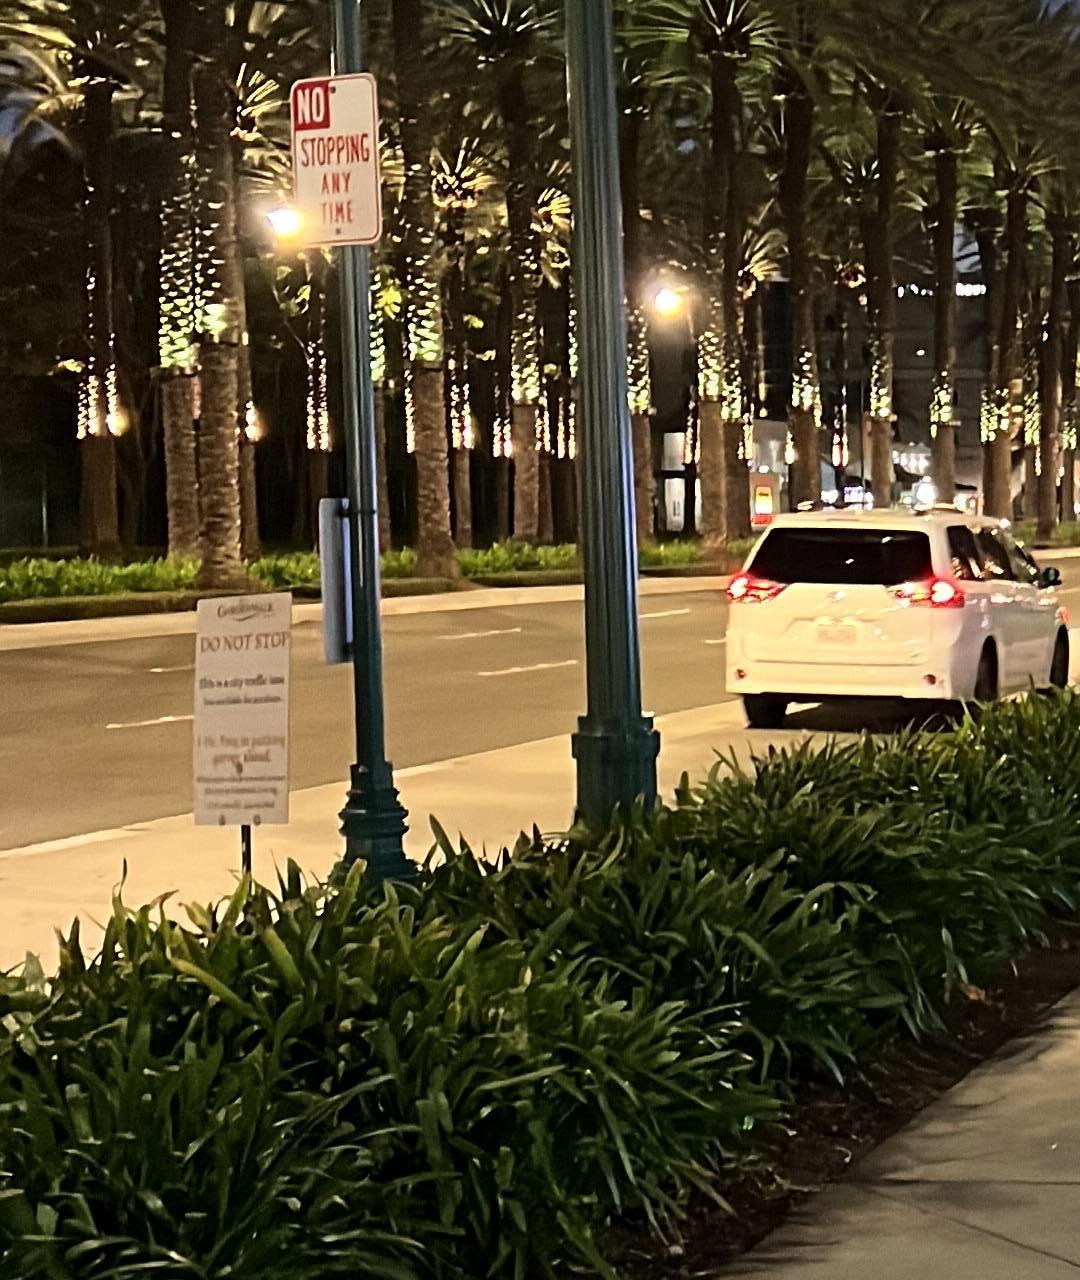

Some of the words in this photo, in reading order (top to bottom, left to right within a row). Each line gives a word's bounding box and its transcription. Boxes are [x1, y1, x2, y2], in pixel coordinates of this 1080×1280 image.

[296, 86, 325, 125] NO
[301, 133, 370, 167] STOPPING
[321, 172, 351, 195] ANY
[321, 199, 354, 225] TIME
[200, 635, 220, 653] DO
[223, 633, 252, 651] NOT
[255, 631, 288, 650] STOP
